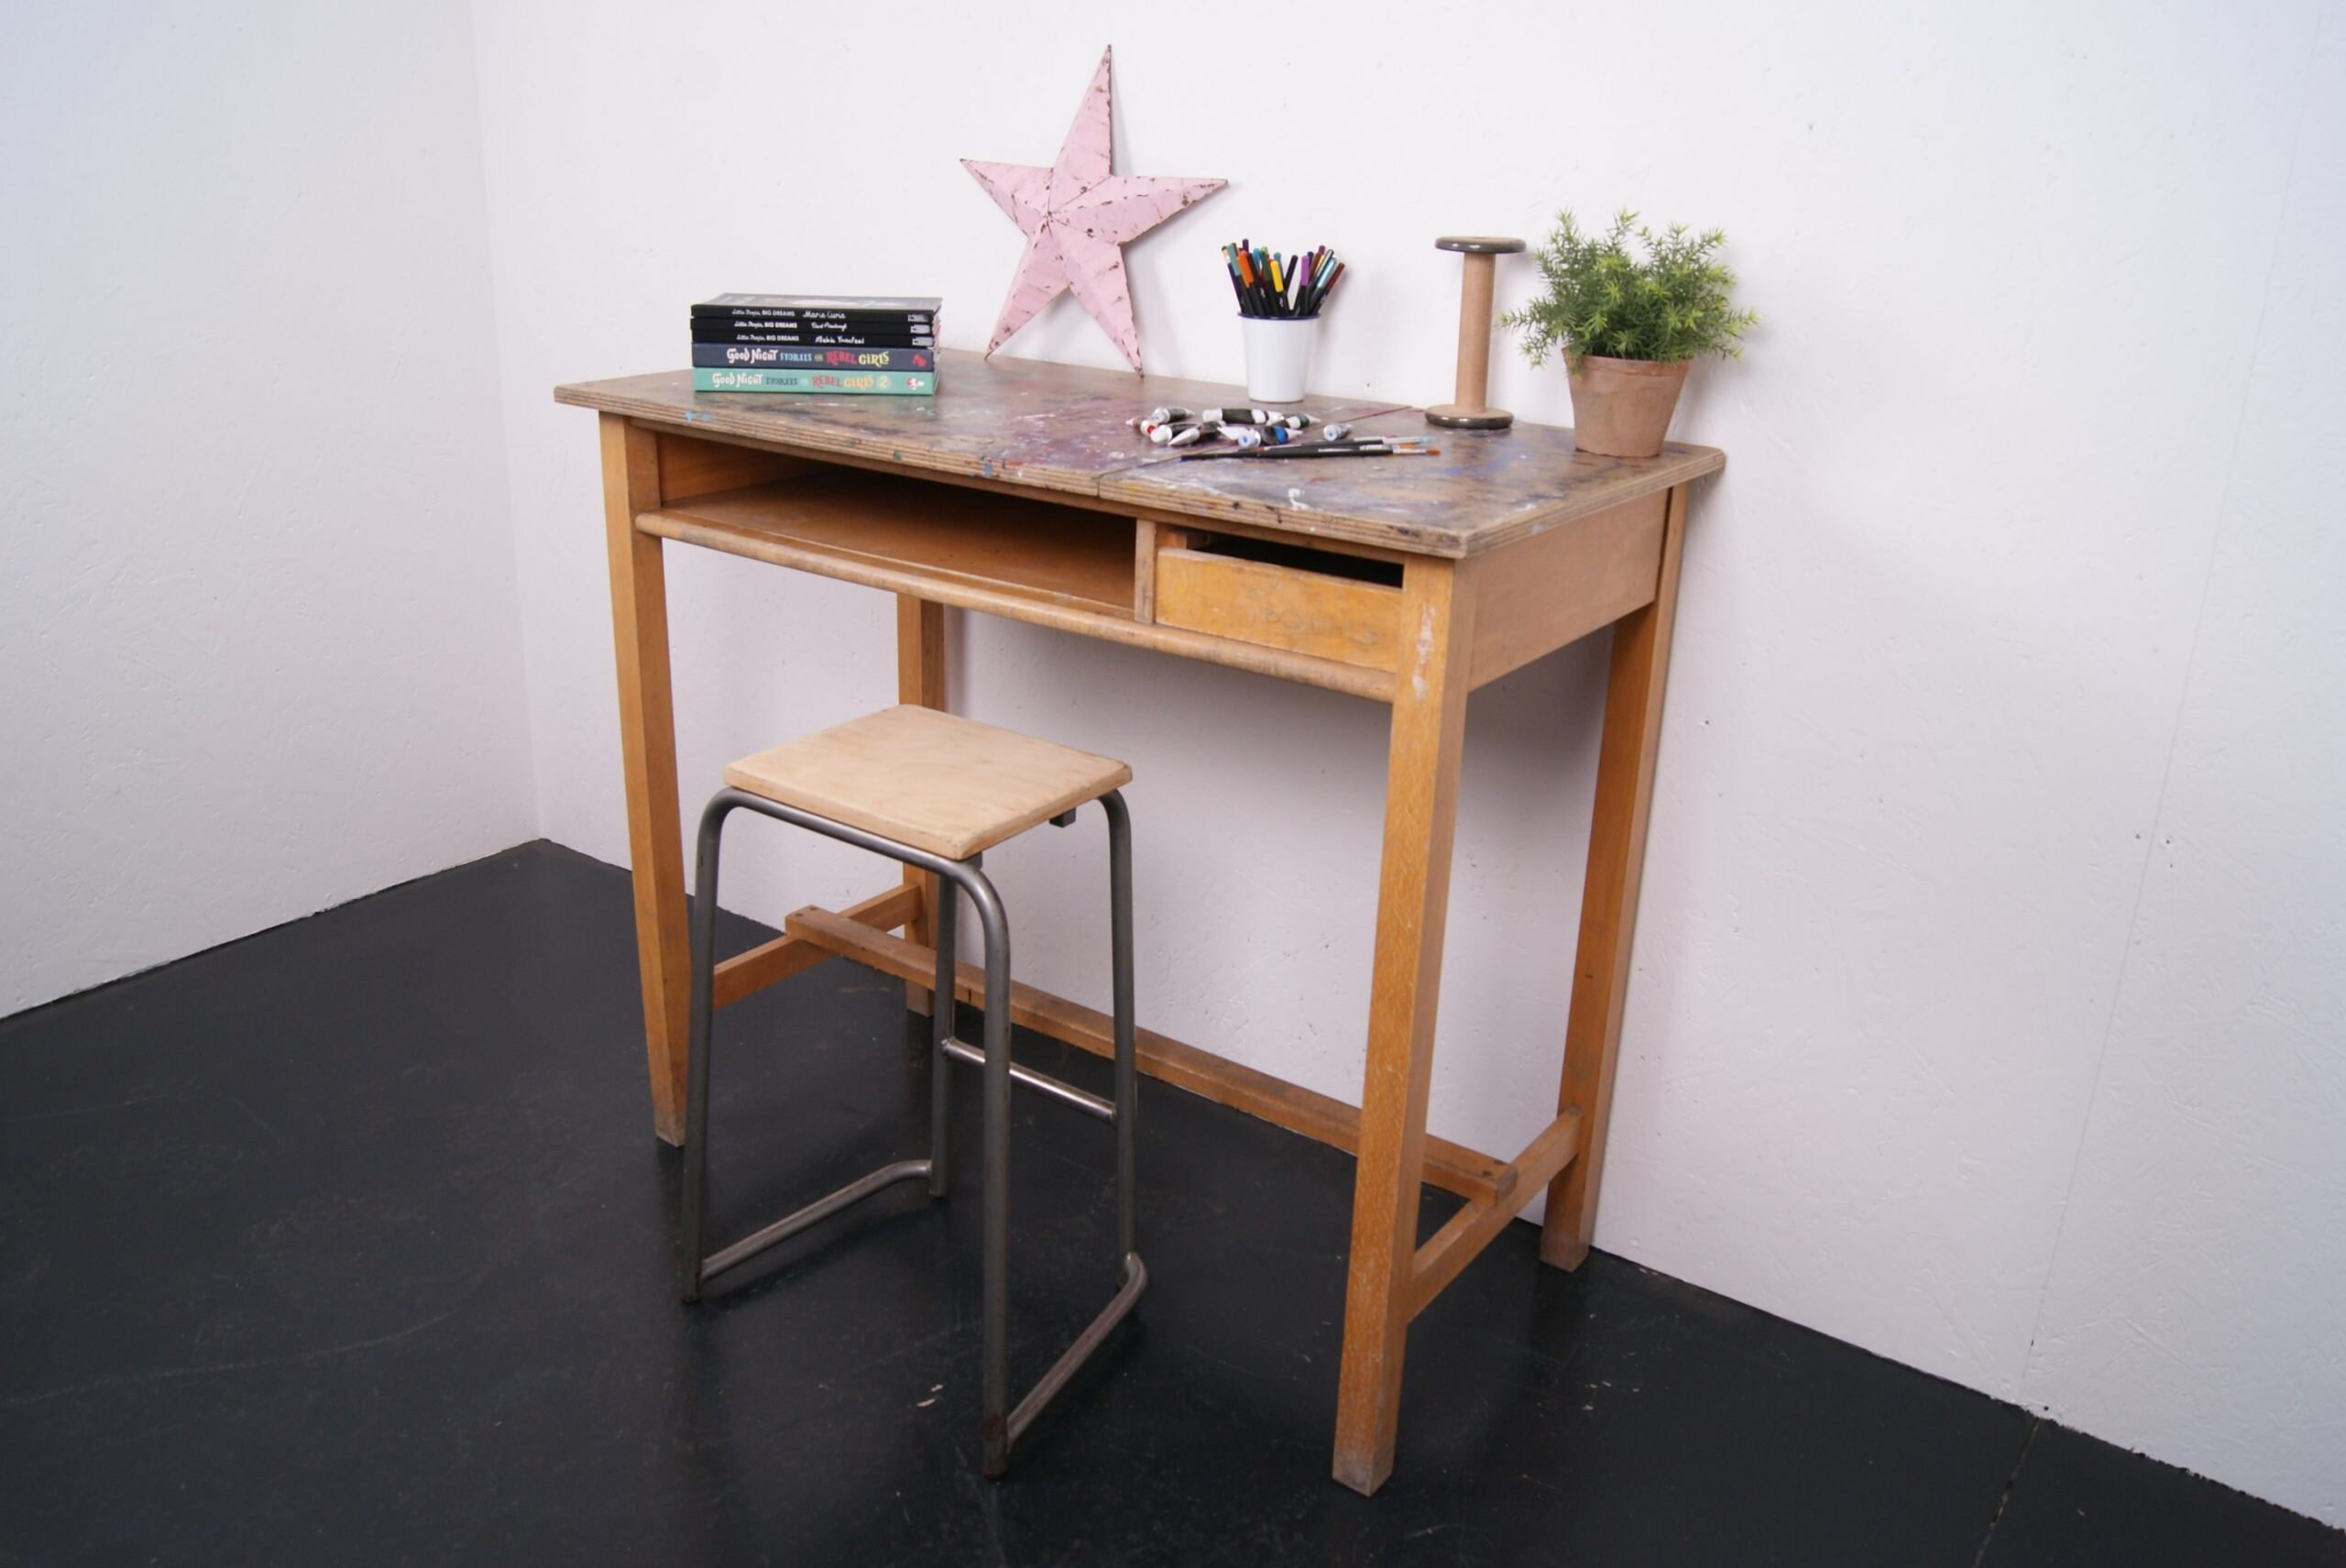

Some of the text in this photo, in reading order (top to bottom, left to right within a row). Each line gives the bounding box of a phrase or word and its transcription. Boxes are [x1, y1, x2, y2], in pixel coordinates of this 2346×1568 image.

[779, 352, 813, 362] STORIES
[826, 350, 858, 366] REBEL
[811, 374, 843, 389] REBEL
